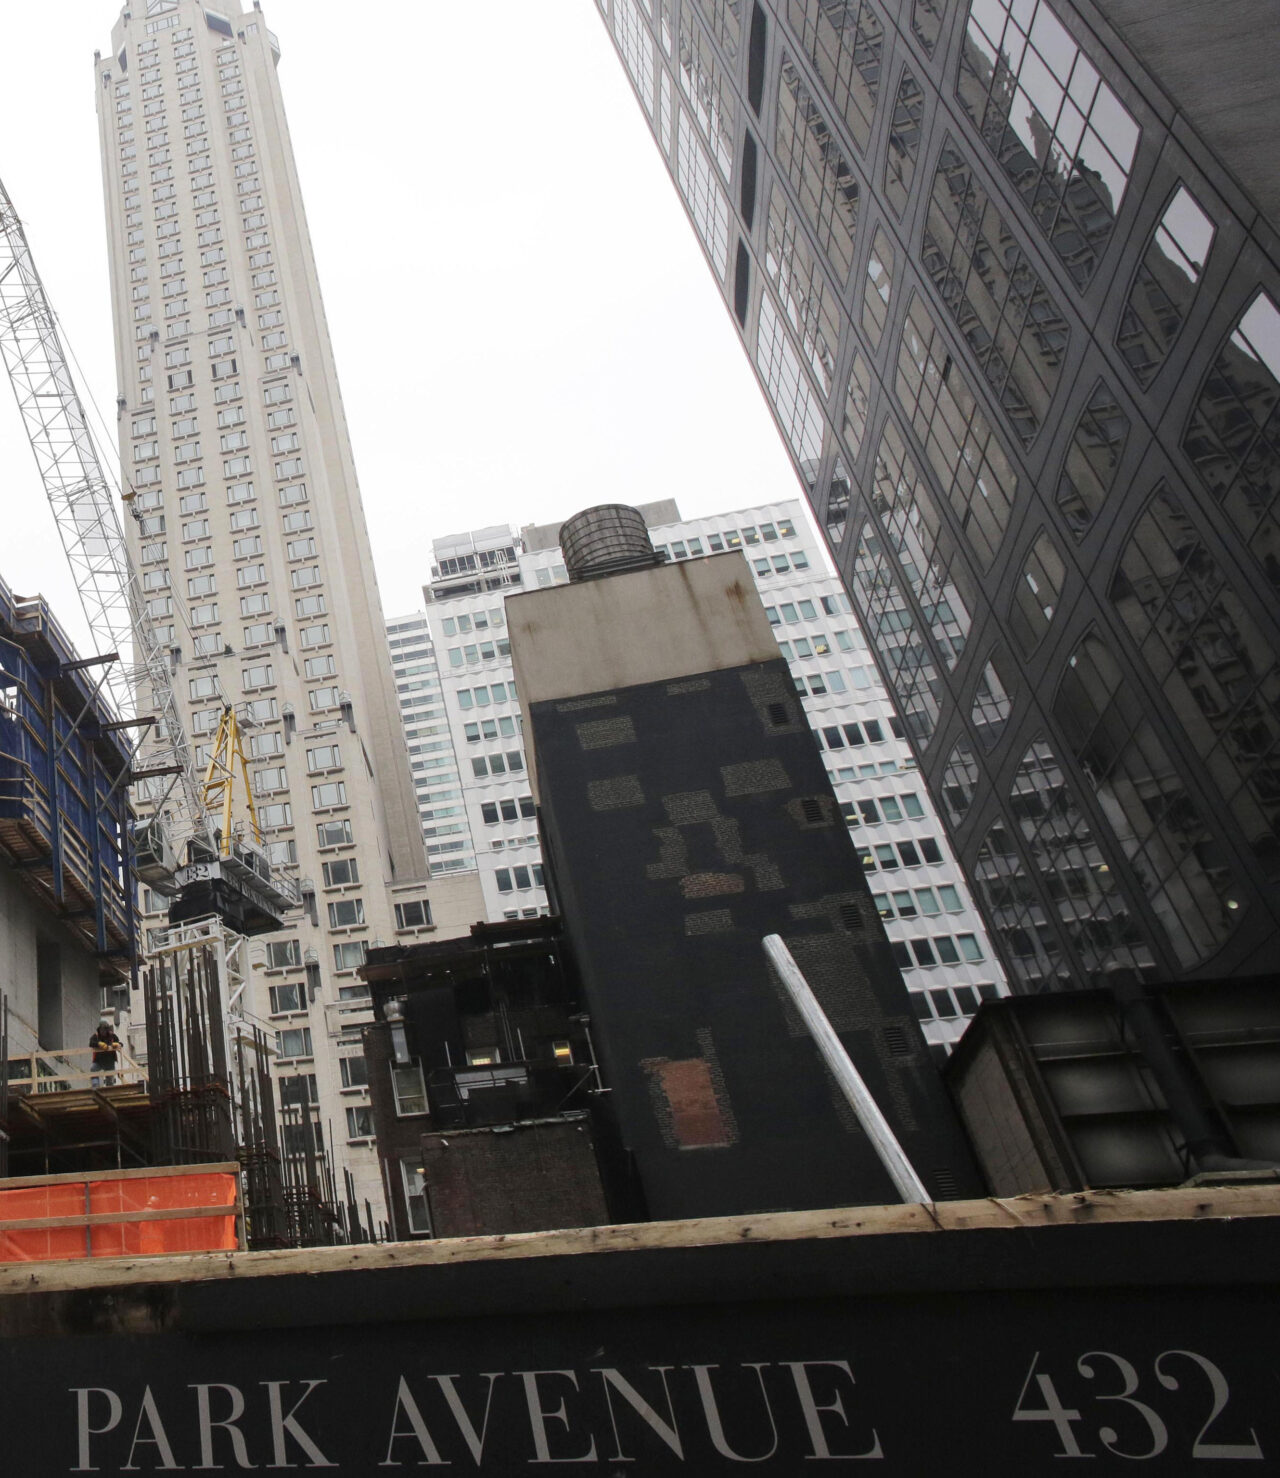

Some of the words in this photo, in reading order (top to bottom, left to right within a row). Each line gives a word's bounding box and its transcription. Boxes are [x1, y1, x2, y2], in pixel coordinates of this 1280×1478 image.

[68, 1380, 341, 1472] PARK
[378, 1359, 886, 1467] AVENUE
[1012, 1350, 1265, 1460] 432
